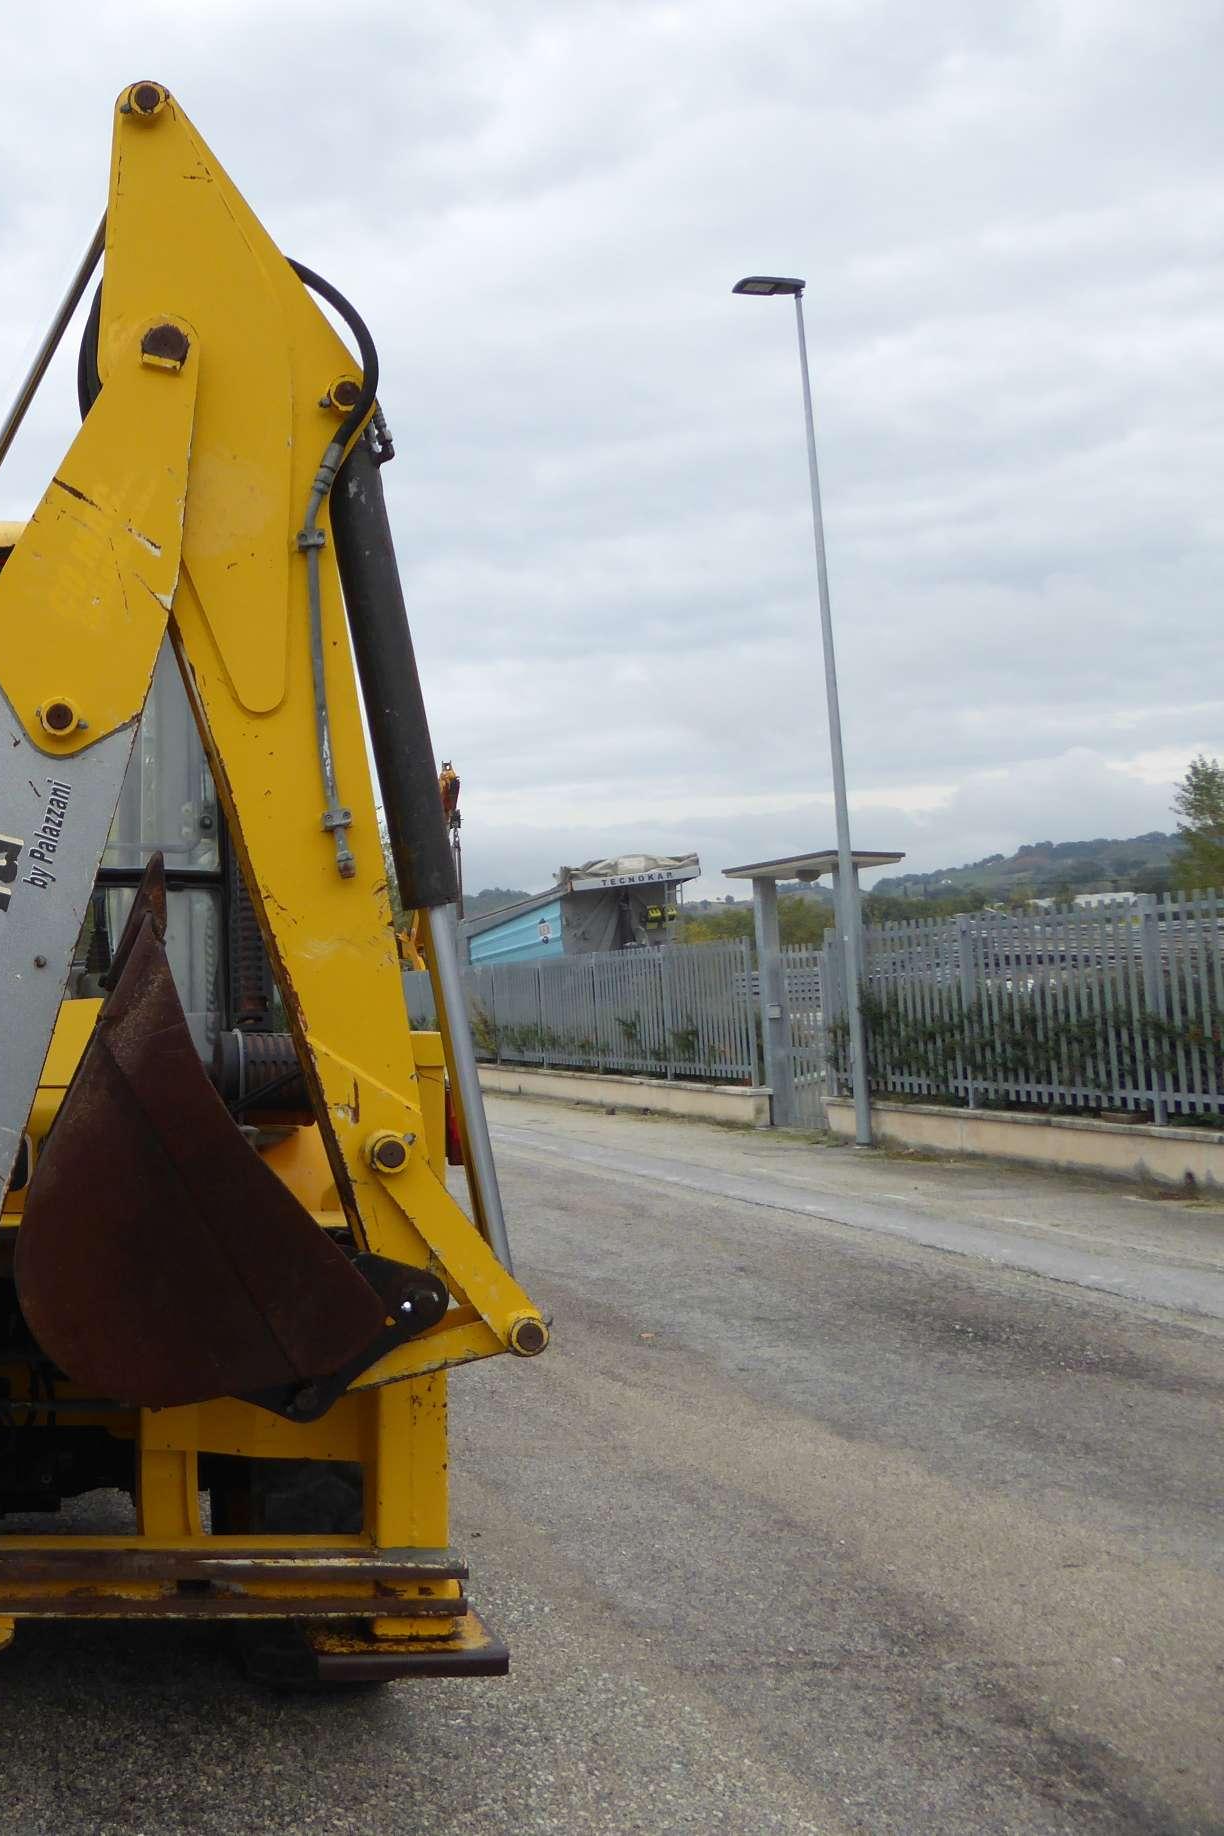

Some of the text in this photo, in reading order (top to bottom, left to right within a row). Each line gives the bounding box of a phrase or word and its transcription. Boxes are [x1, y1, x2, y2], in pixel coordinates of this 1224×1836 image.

[22, 777, 72, 890] by Palazzani
[601, 870, 674, 887] TECNOKAR
